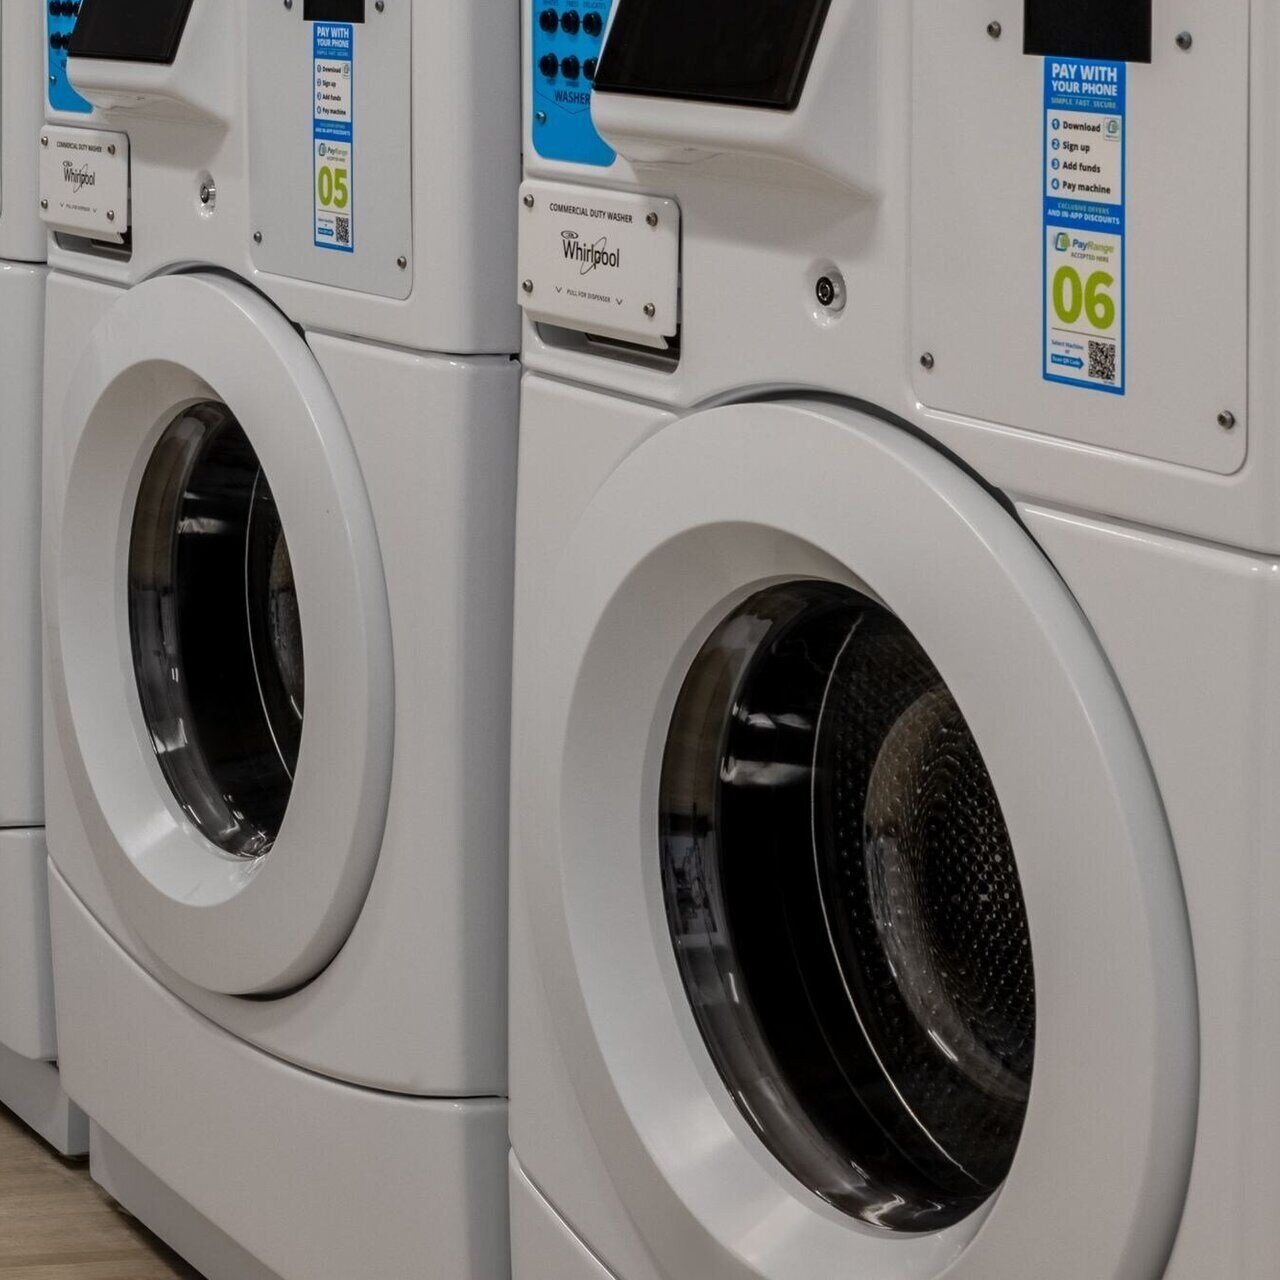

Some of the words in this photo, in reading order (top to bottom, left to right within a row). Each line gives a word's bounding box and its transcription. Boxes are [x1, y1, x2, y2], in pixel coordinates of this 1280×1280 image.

[316, 26, 330, 38] PAY
[330, 27, 350, 39] WITH
[1051, 63, 1078, 80] PAY
[1080, 65, 1118, 82] WITH
[1051, 80, 1080, 94] YOUR
[1082, 82, 1118, 96] PHONE
[554, 90, 591, 105] WASHER
[1062, 120, 1102, 133] Download
[1062, 141, 1079, 152] Sign
[1080, 145, 1090, 154] up
[1062, 161, 1078, 170] Add
[1079, 163, 1101, 173] funds
[63, 167, 96, 189] Whirlpool
[318, 165, 348, 209] 05
[1062, 181, 1077, 192] Pay
[1078, 183, 1111, 194] machine
[549, 202, 589, 217] COMMERCIAL
[589, 209, 607, 220] DUTY
[606, 211, 633, 223] WASHER
[1047, 209, 1061, 217] AND
[1061, 210, 1083, 220] IN-APP
[1083, 214, 1120, 225] DISCOUNTS
[1072, 238, 1115, 254] PayRange
[562, 239, 620, 270] Whirlpool
[1052, 265, 1115, 330] 06
